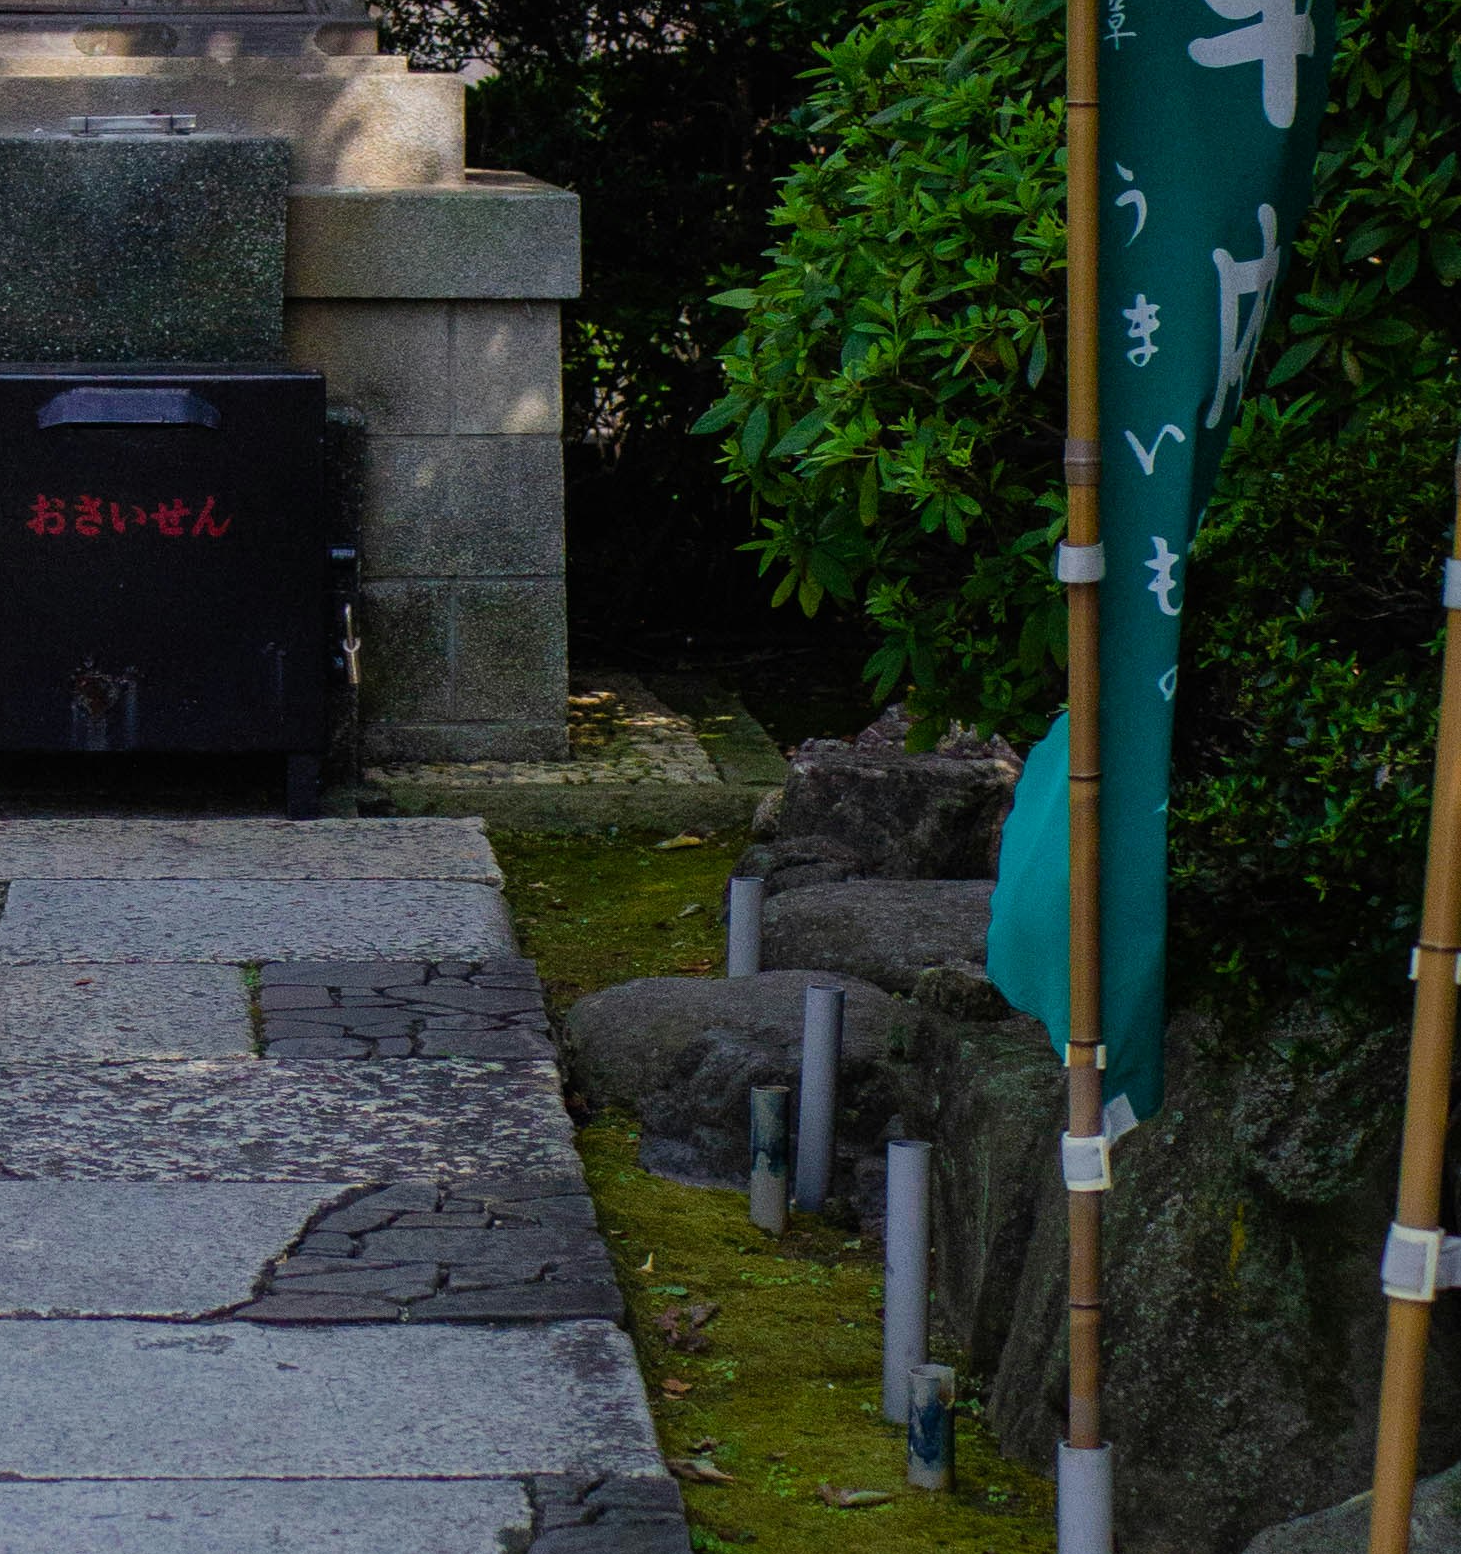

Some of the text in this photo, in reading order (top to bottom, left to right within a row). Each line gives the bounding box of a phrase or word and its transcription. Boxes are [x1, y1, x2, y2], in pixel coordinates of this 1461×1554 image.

[26, 494, 234, 537] おさいせん
